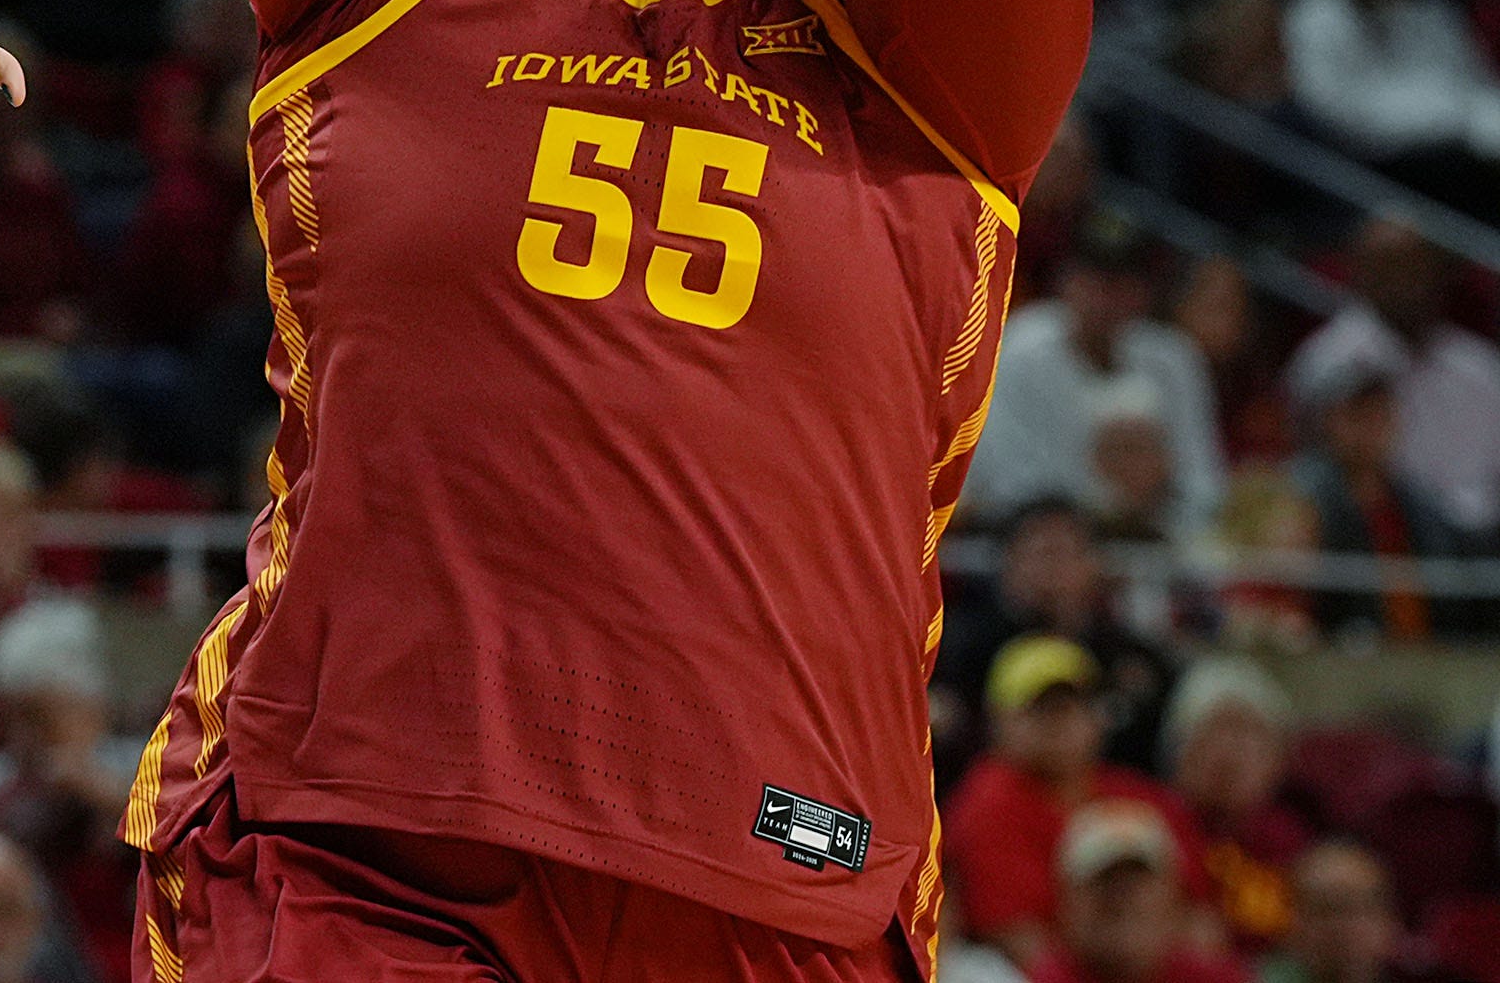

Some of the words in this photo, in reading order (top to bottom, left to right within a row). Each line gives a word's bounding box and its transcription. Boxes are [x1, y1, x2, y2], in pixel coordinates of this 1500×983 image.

[485, 52, 652, 89] IOWA
[663, 46, 824, 156] STATE
[516, 106, 769, 330] 55
[763, 817, 789, 832] TEAM
[835, 826, 852, 851] 54
